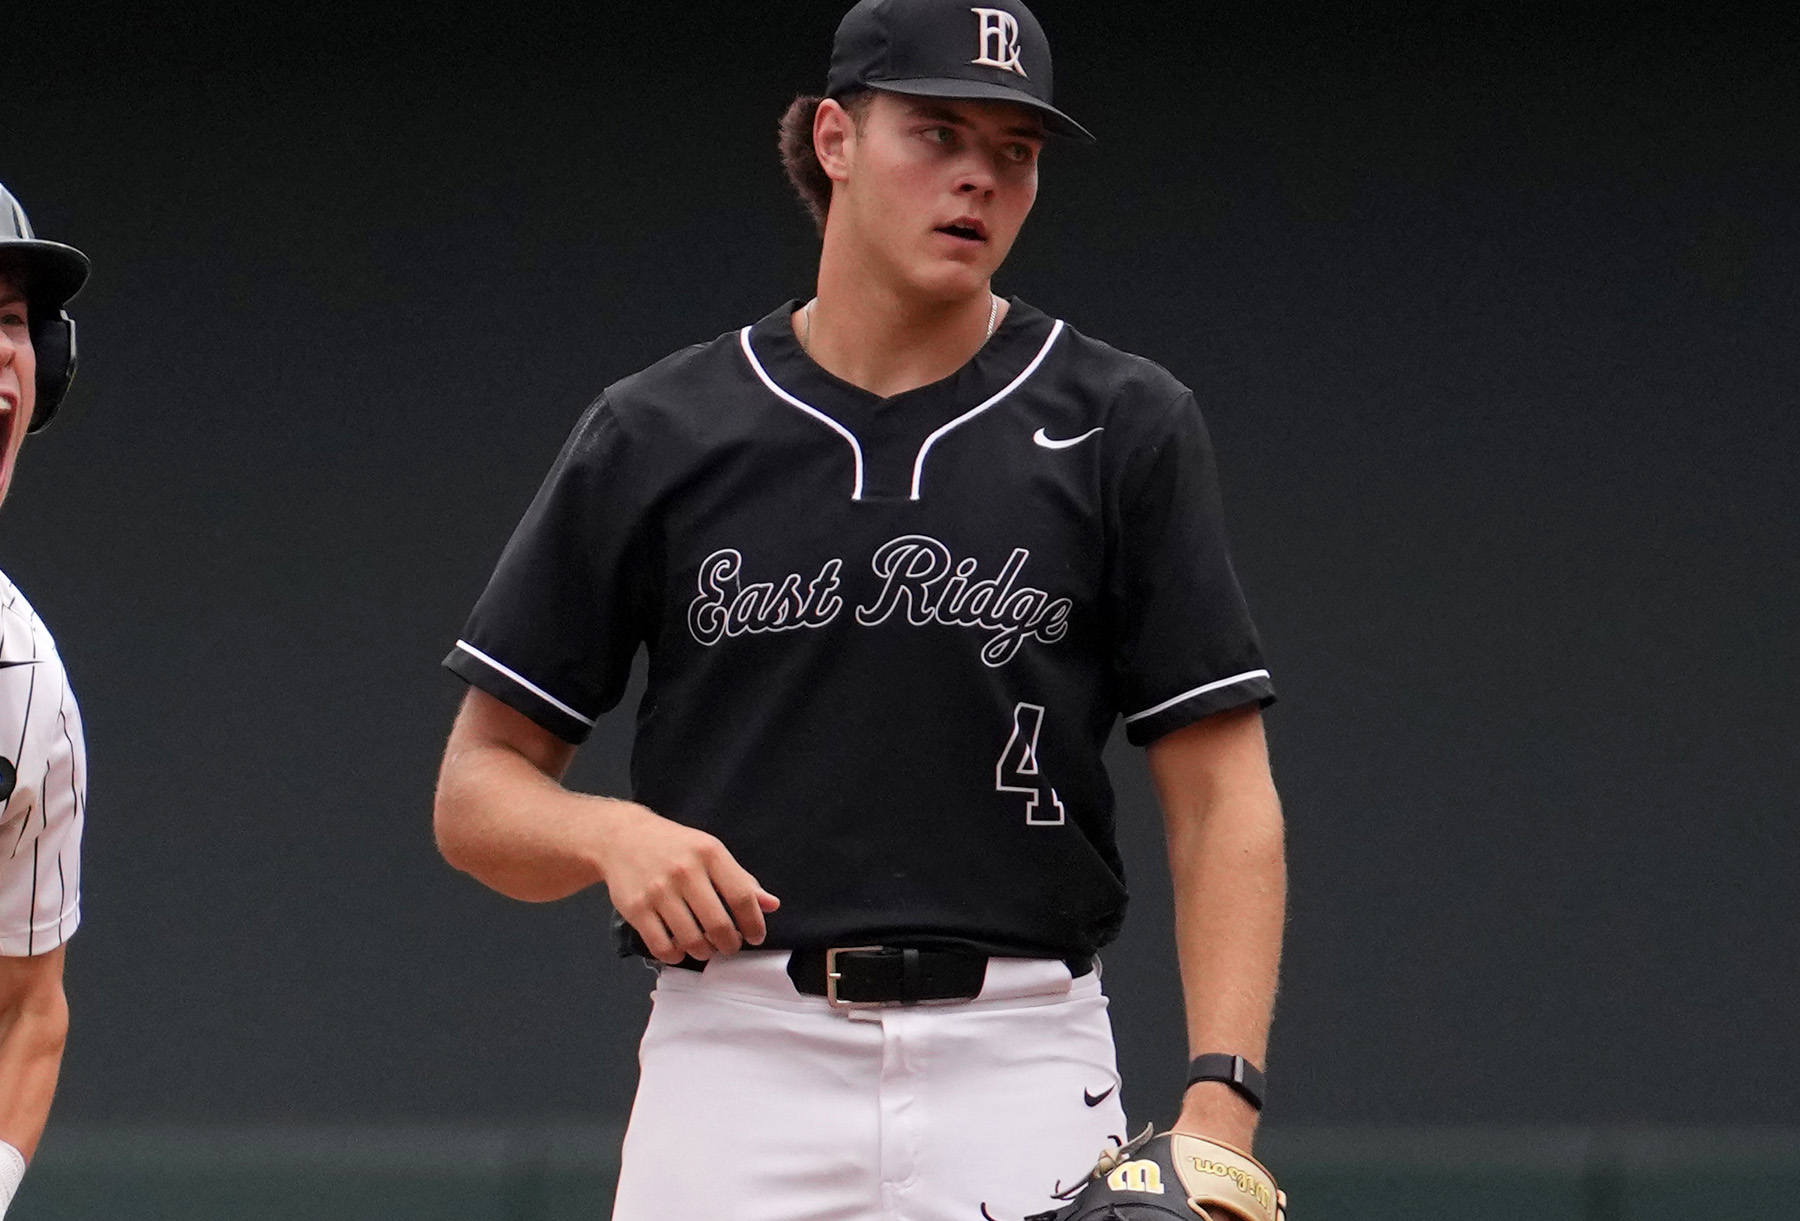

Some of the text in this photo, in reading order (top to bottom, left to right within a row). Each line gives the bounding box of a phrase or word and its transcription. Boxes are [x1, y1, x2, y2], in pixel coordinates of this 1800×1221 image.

[687, 534, 1073, 667] East Ridge
[995, 701, 1065, 826] 4
